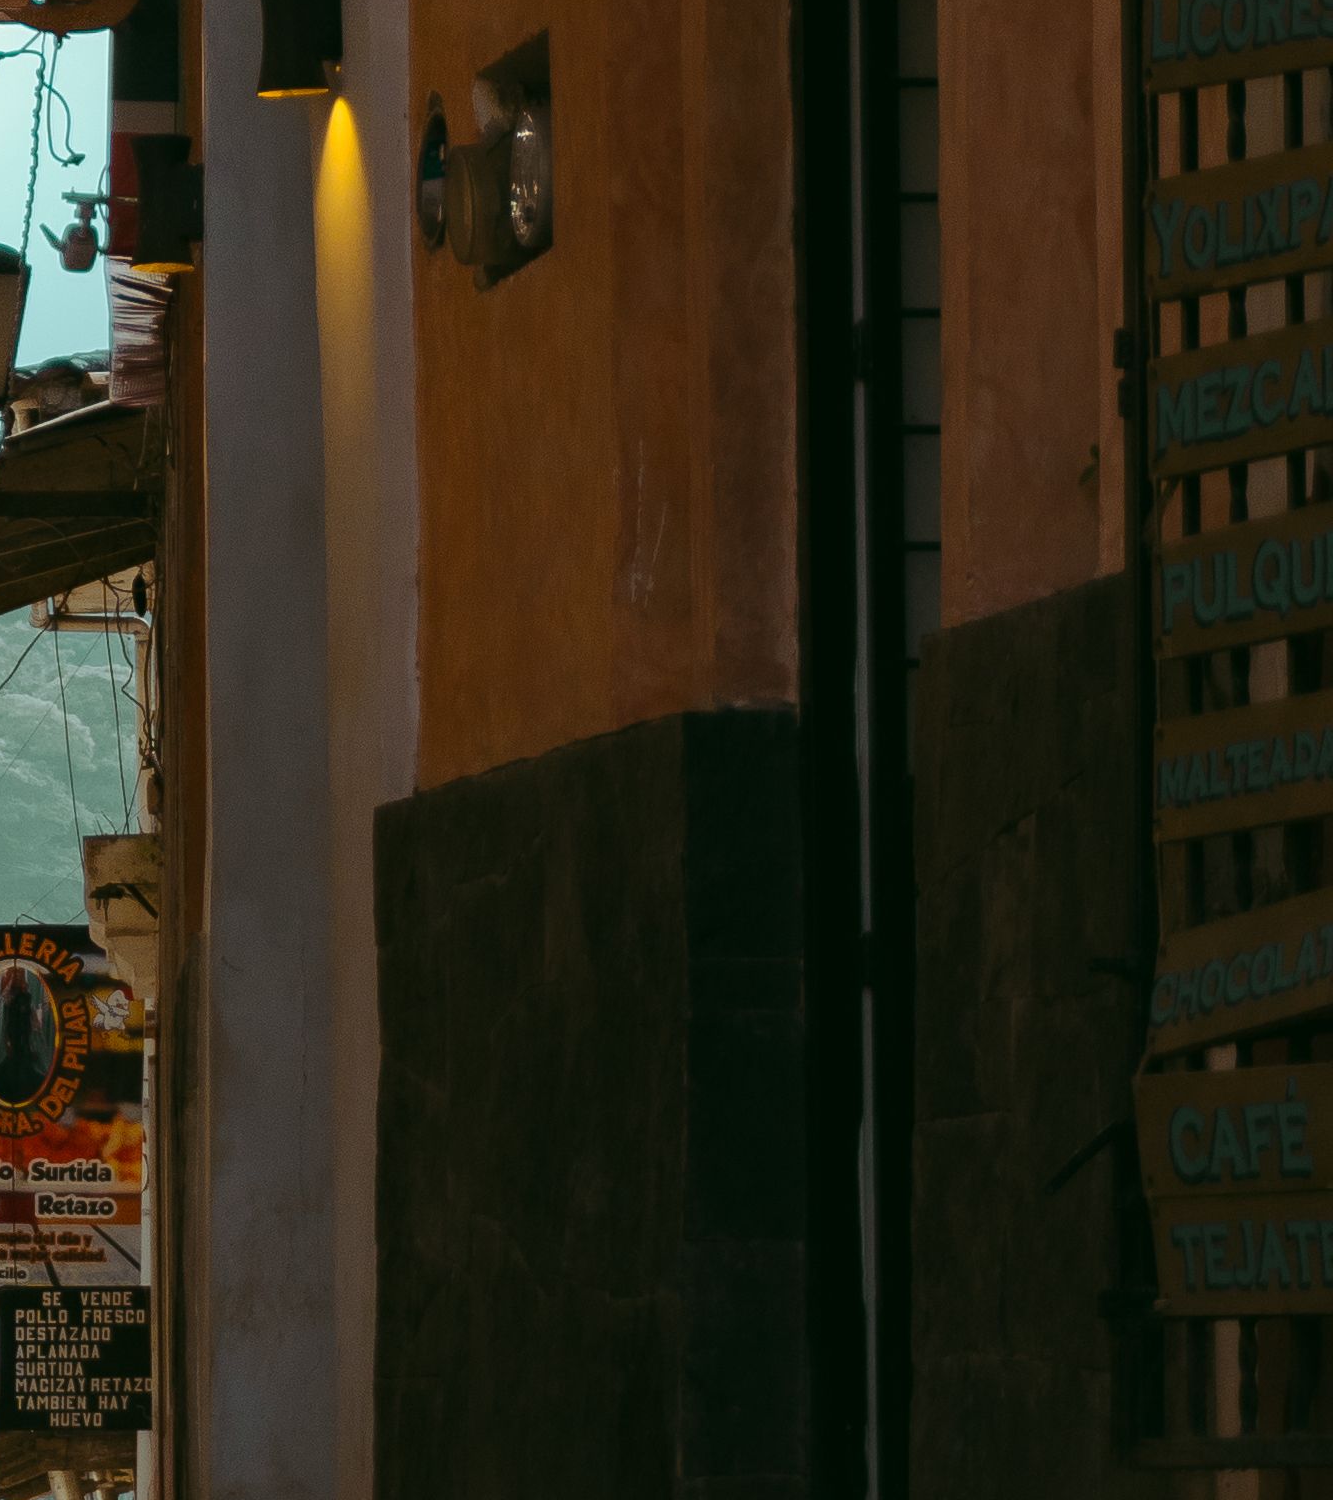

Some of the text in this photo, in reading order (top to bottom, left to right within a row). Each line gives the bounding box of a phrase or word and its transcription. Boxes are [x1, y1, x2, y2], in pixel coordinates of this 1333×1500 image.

[40, 1074, 80, 1119] DEL
[63, 995, 88, 1072] PILAR
[1169, 1077, 1313, 1185] CAFÉ
[30, 1161, 112, 1182] Surtida
[38, 1194, 114, 1216] Retazo
[42, 1291, 132, 1306] SE VENDE
[15, 1309, 145, 1324] POLLO FRESCO
[15, 1327, 111, 1341] DESTAZADO
[16, 1344, 100, 1359] APLANADA
[15, 1362, 84, 1376] SURTIDA
[91, 1377, 152, 1392] RETAZO
[16, 1395, 129, 1410] TAMBIEN HAY
[50, 1412, 103, 1427] HUEVO
